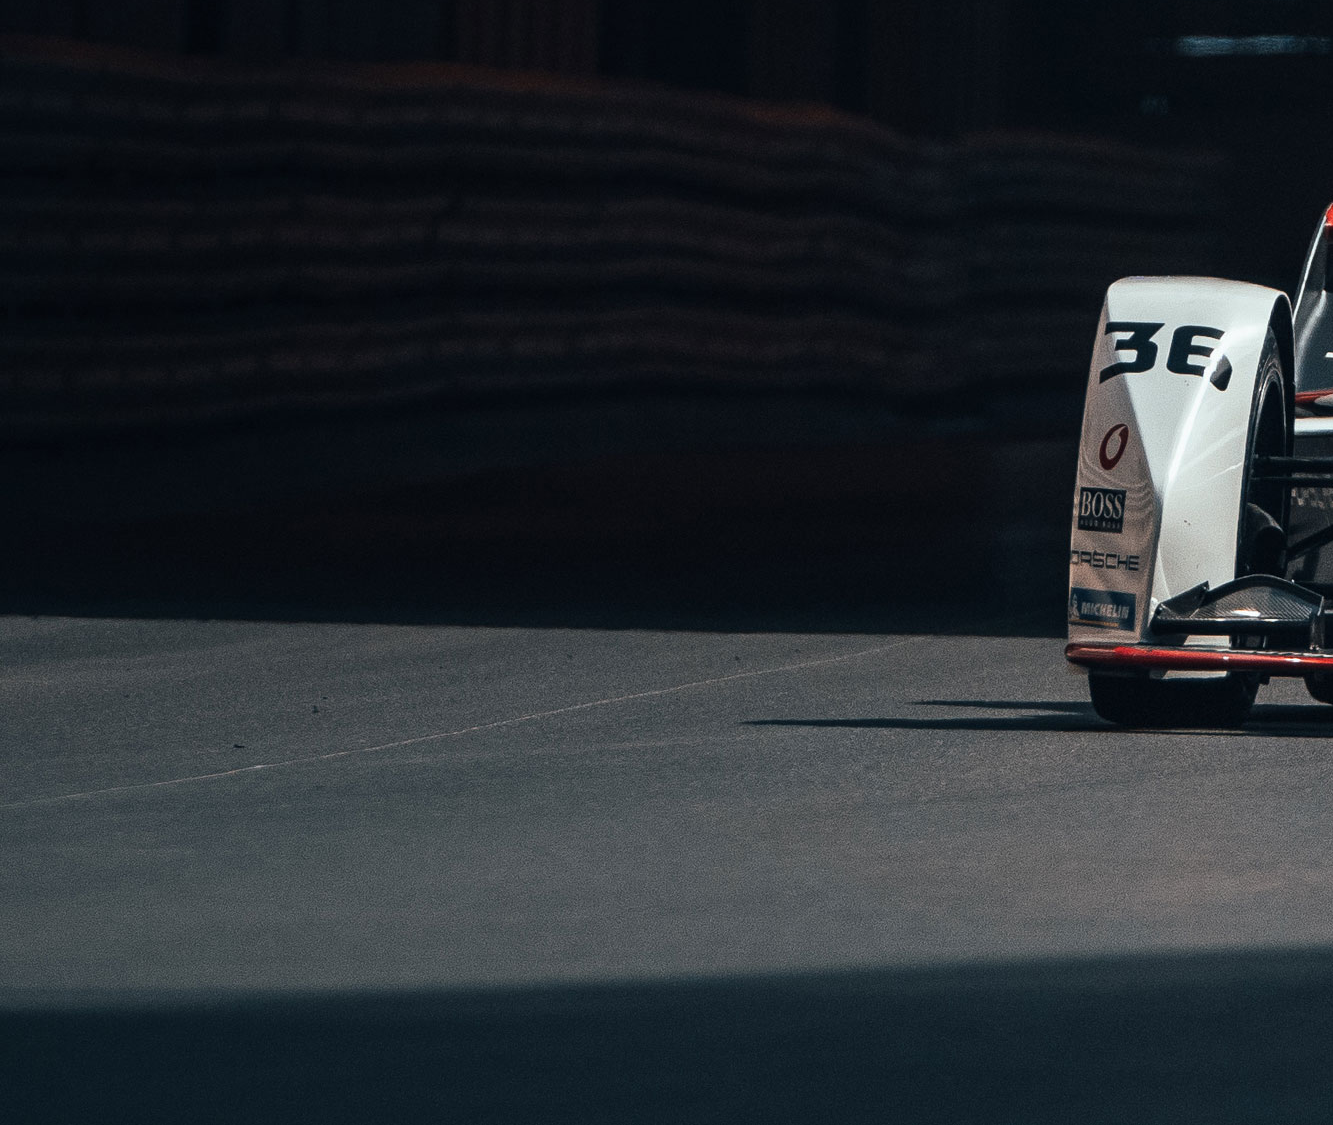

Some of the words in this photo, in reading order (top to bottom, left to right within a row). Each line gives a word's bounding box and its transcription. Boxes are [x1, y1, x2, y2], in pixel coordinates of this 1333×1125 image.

[1098, 321, 1233, 392] 36
[1081, 491, 1123, 519] BOSS
[1069, 549, 1140, 571] ORSCHE
[1080, 601, 1131, 619] MICHELIN
